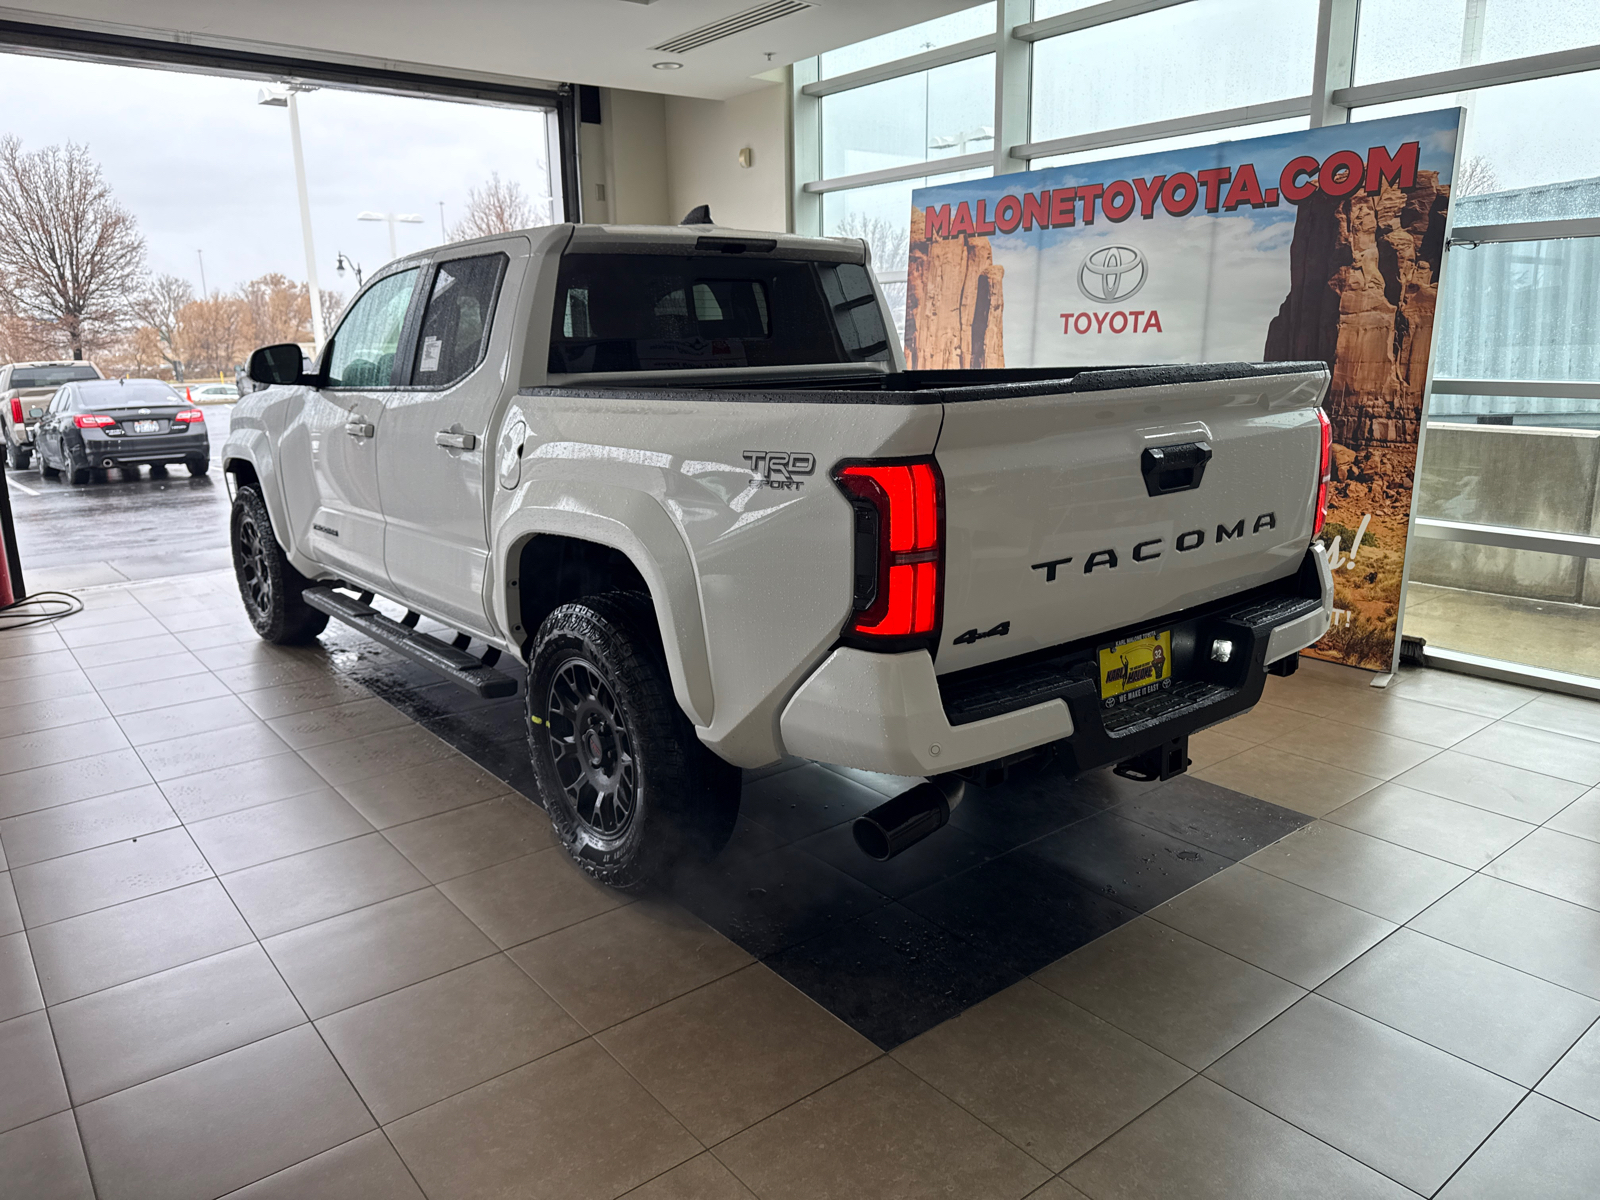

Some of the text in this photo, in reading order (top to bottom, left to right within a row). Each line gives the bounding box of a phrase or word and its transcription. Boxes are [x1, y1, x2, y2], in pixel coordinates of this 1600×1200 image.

[924, 141, 1420, 242] MALONETOYOTA.COM
[1060, 309, 1163, 335] TOYOTA
[742, 450, 816, 481] TRD
[1031, 512, 1276, 582] TACOMA
[1154, 649, 1162, 659] 32
[1119, 695, 1127, 703] WE
[1127, 690, 1141, 700] MAKE
[1147, 684, 1159, 693] EASY
